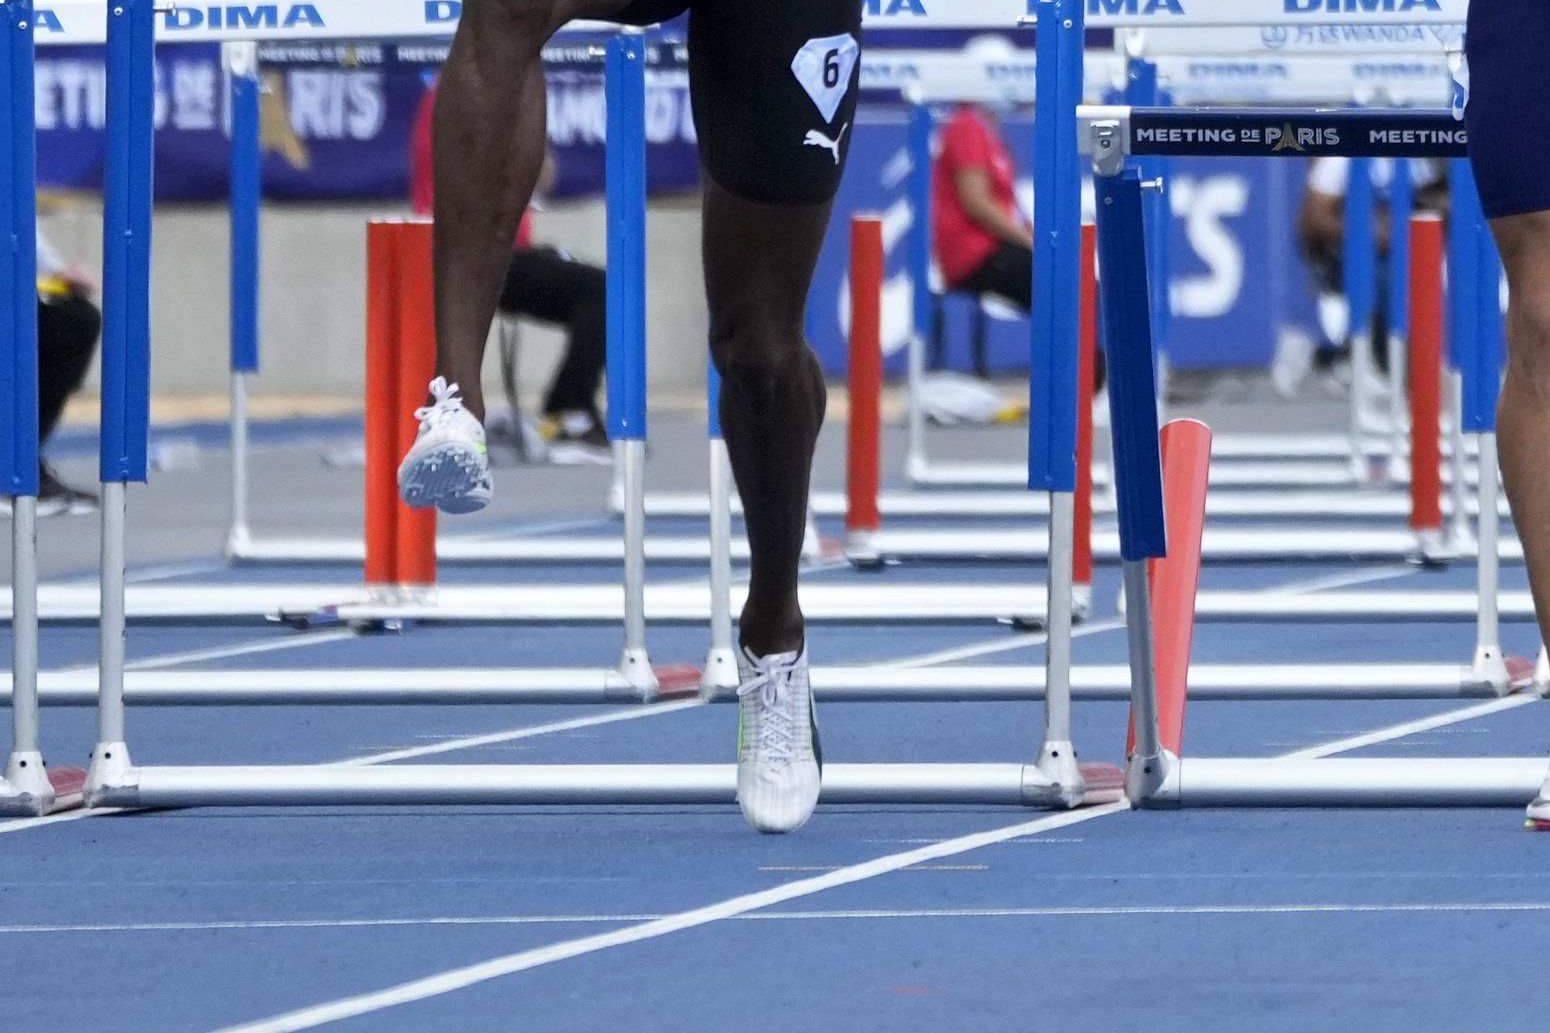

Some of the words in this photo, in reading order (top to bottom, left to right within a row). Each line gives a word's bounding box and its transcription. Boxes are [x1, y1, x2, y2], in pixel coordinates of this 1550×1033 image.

[163, 3, 327, 31] DIMA
[823, 48, 840, 89] 6
[1136, 128, 1236, 143] MEETING
[1240, 129, 1260, 143] DE
[1265, 123, 1340, 152] PARIS
[1369, 129, 1468, 144] MEETING
